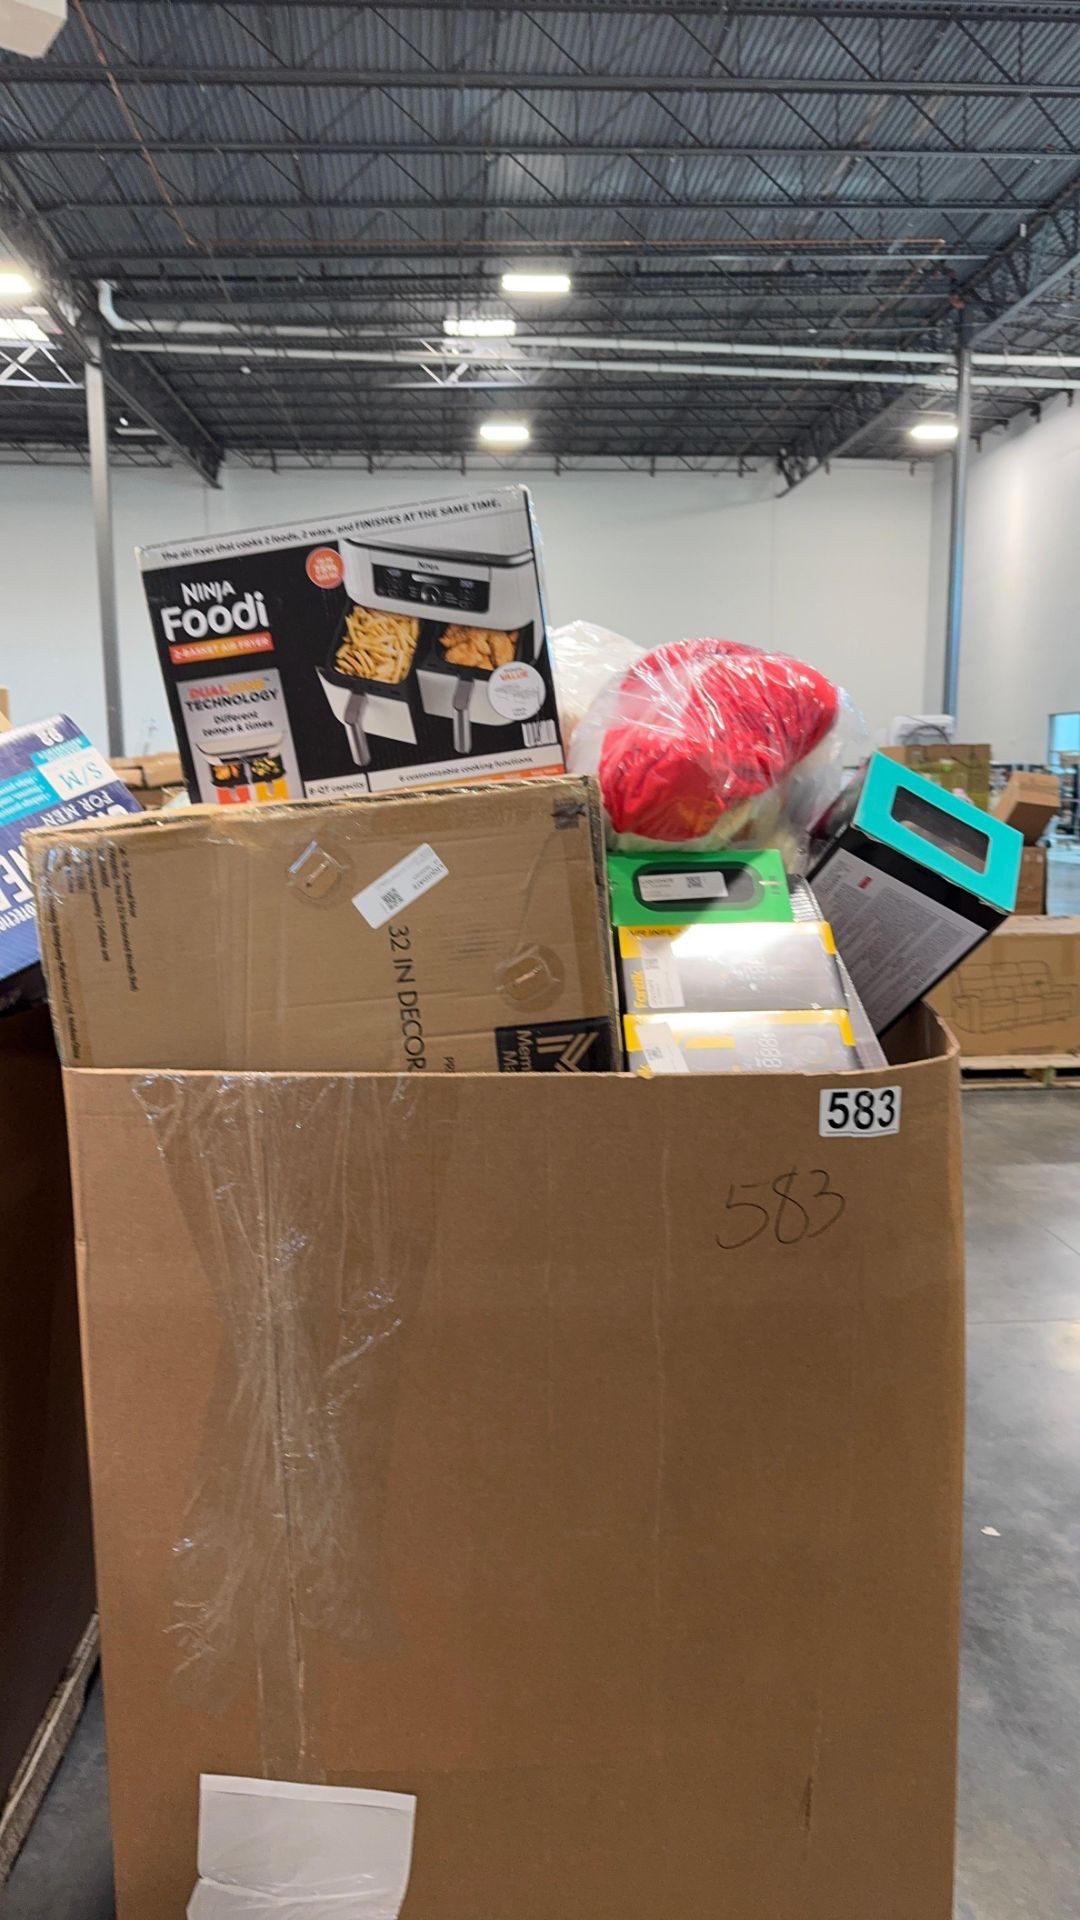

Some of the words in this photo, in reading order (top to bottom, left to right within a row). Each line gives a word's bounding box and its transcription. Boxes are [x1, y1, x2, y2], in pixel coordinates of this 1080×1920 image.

[402, 511, 417, 524] AT
[440, 504, 470, 516] SAME
[180, 580, 238, 606] NINJA
[160, 590, 270, 642] Foodi
[185, 688, 278, 712] TECHNOLOGY
[213, 710, 259, 725] Different
[58, 761, 103, 790] S/M
[77, 790, 114, 812] FOR
[40, 804, 81, 827] MEN
[388, 925, 411, 952] 32
[392, 958, 416, 984] IN
[397, 990, 426, 1072] DECOR
[503, 1050, 520, 1073] Ma
[516, 1029, 534, 1073] Mem
[827, 1089, 896, 1131] 583
[715, 1166, 847, 1250] 583
